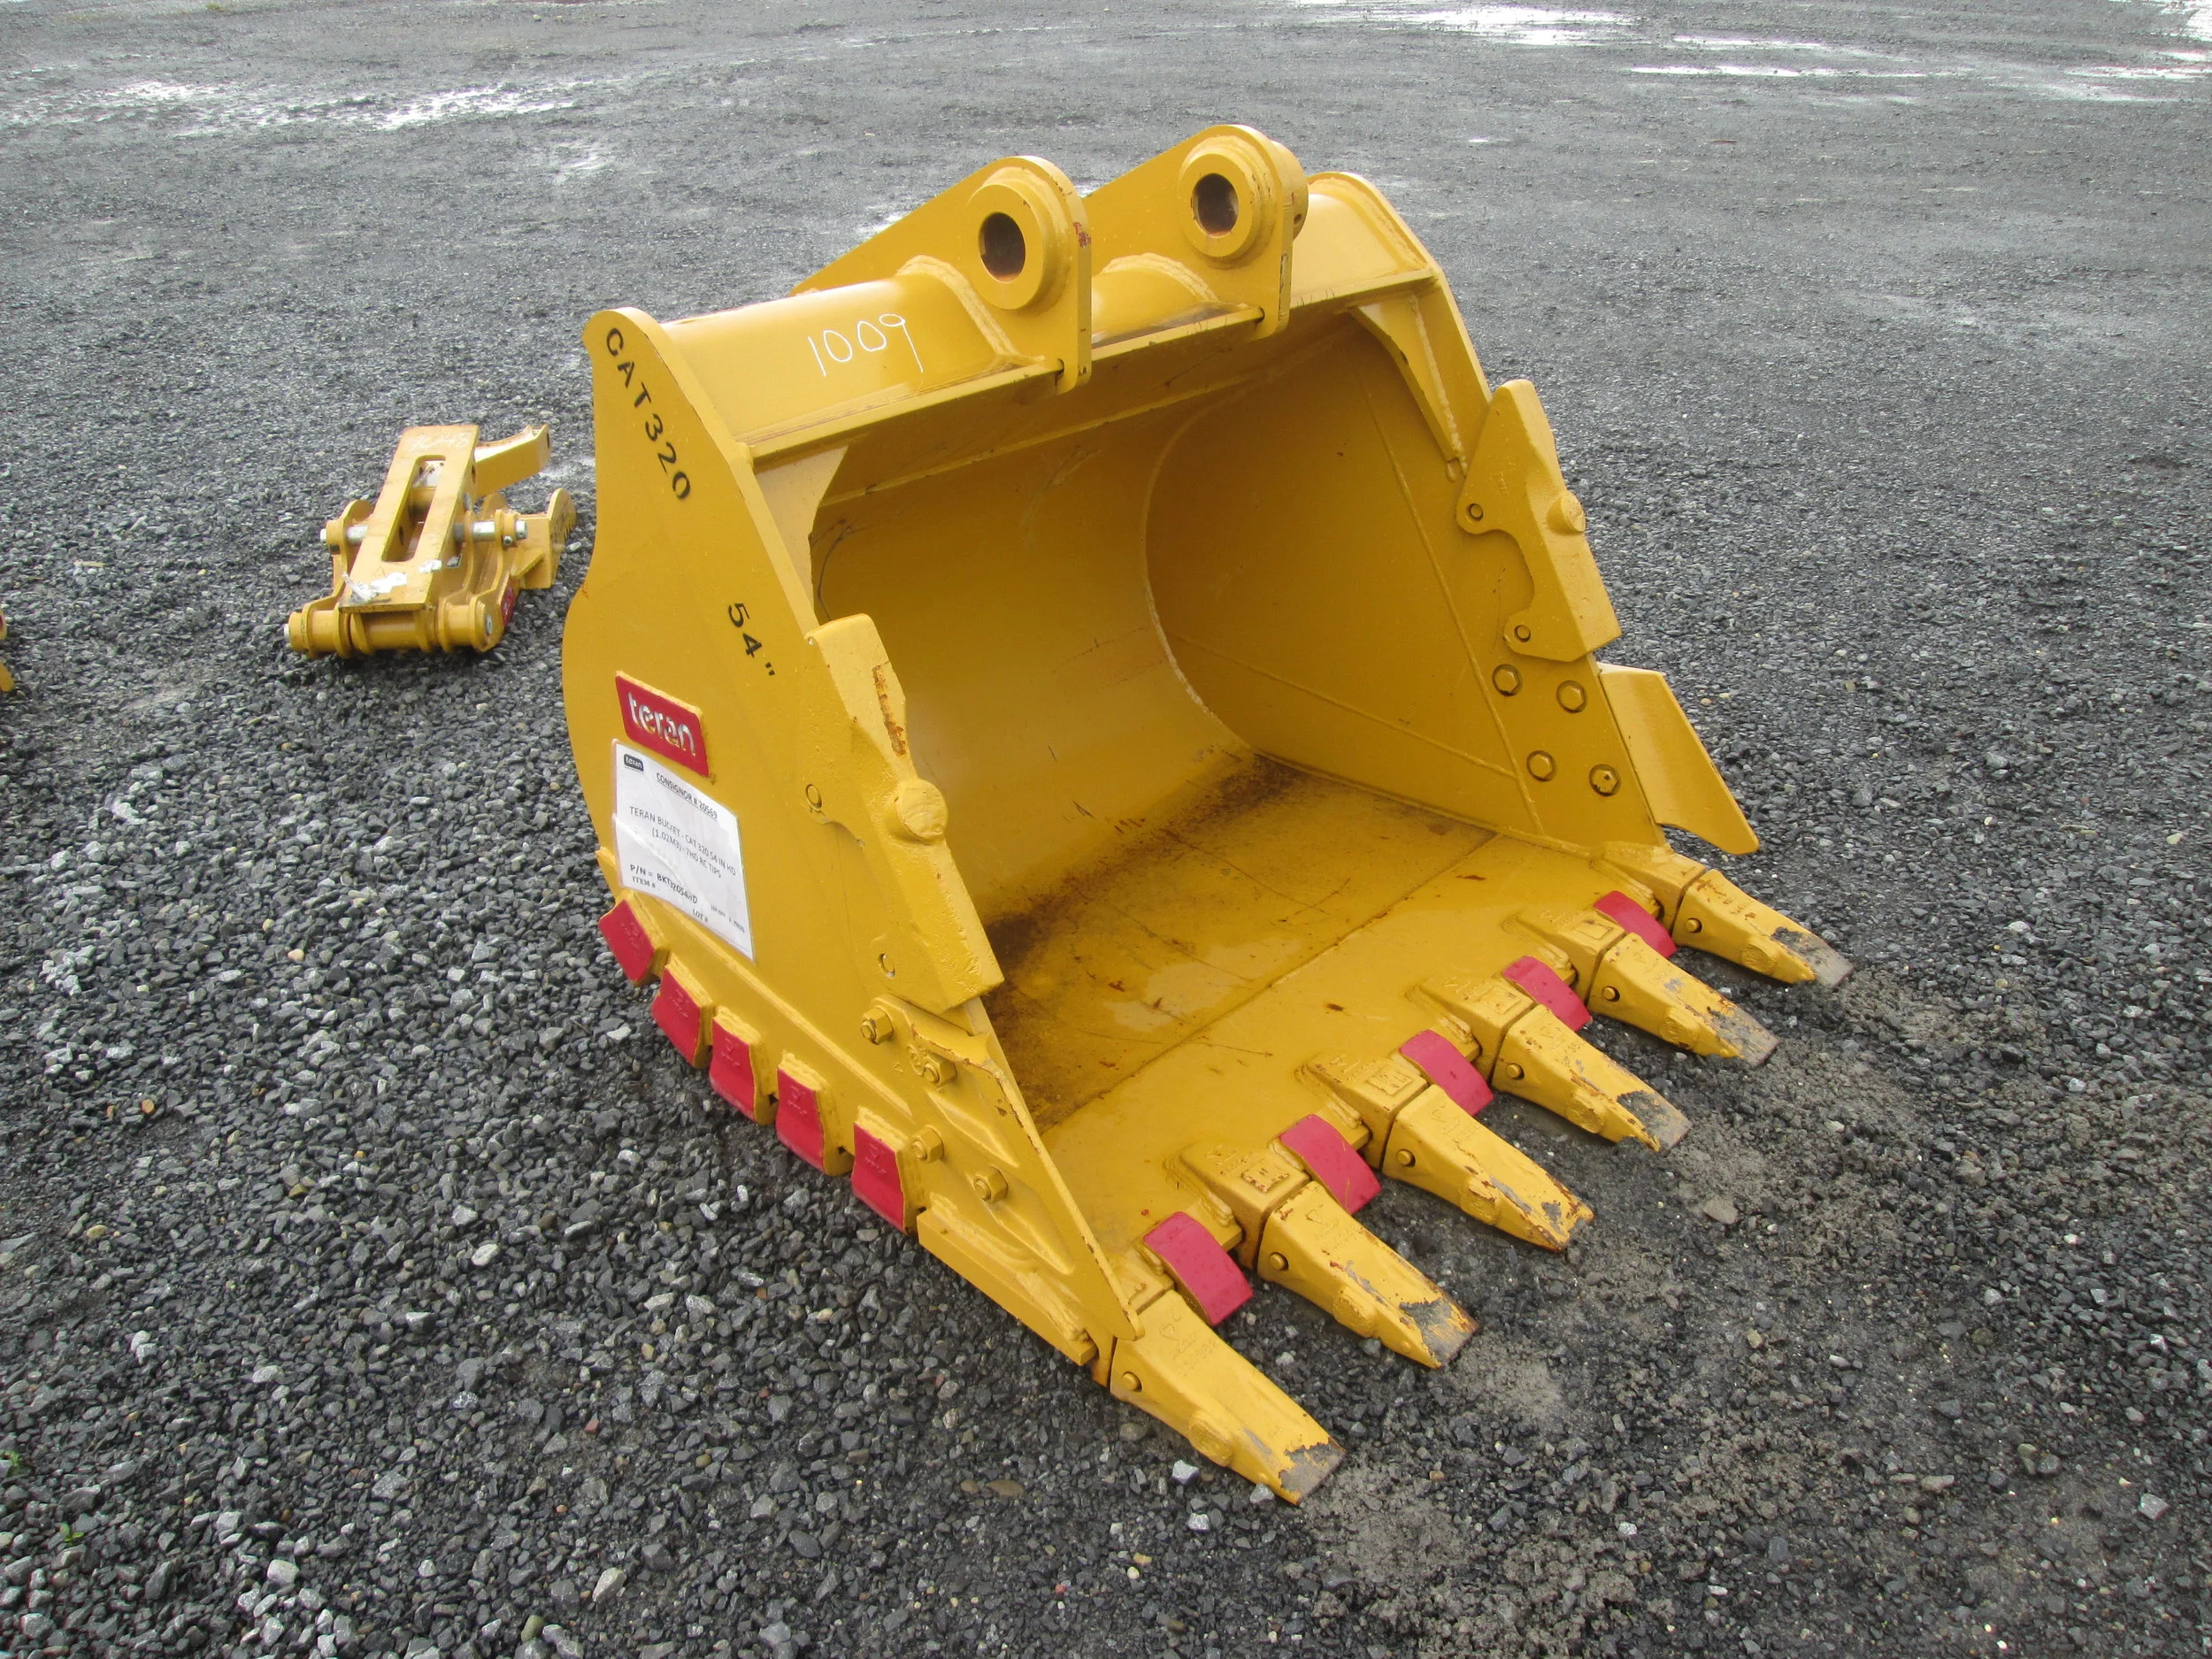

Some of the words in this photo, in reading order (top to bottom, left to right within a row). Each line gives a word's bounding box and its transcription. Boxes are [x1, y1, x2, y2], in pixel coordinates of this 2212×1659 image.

[807, 313, 924, 377] 1009
[627, 691, 696, 757] teran
[625, 756, 642, 769] teran
[657, 772, 693, 803] CONSIGNOR
[629, 806, 656, 823] TERAN
[657, 816, 680, 837] BUCKET
[685, 834, 697, 848] CAT
[697, 843, 709, 856] 320
[718, 857, 726, 869] IN
[726, 864, 736, 876] HD
[651, 827, 682, 852] (1.02M3)
[630, 864, 646, 876] P/N
[632, 875, 650, 887] ITEM
[693, 909, 703, 920] LOT
